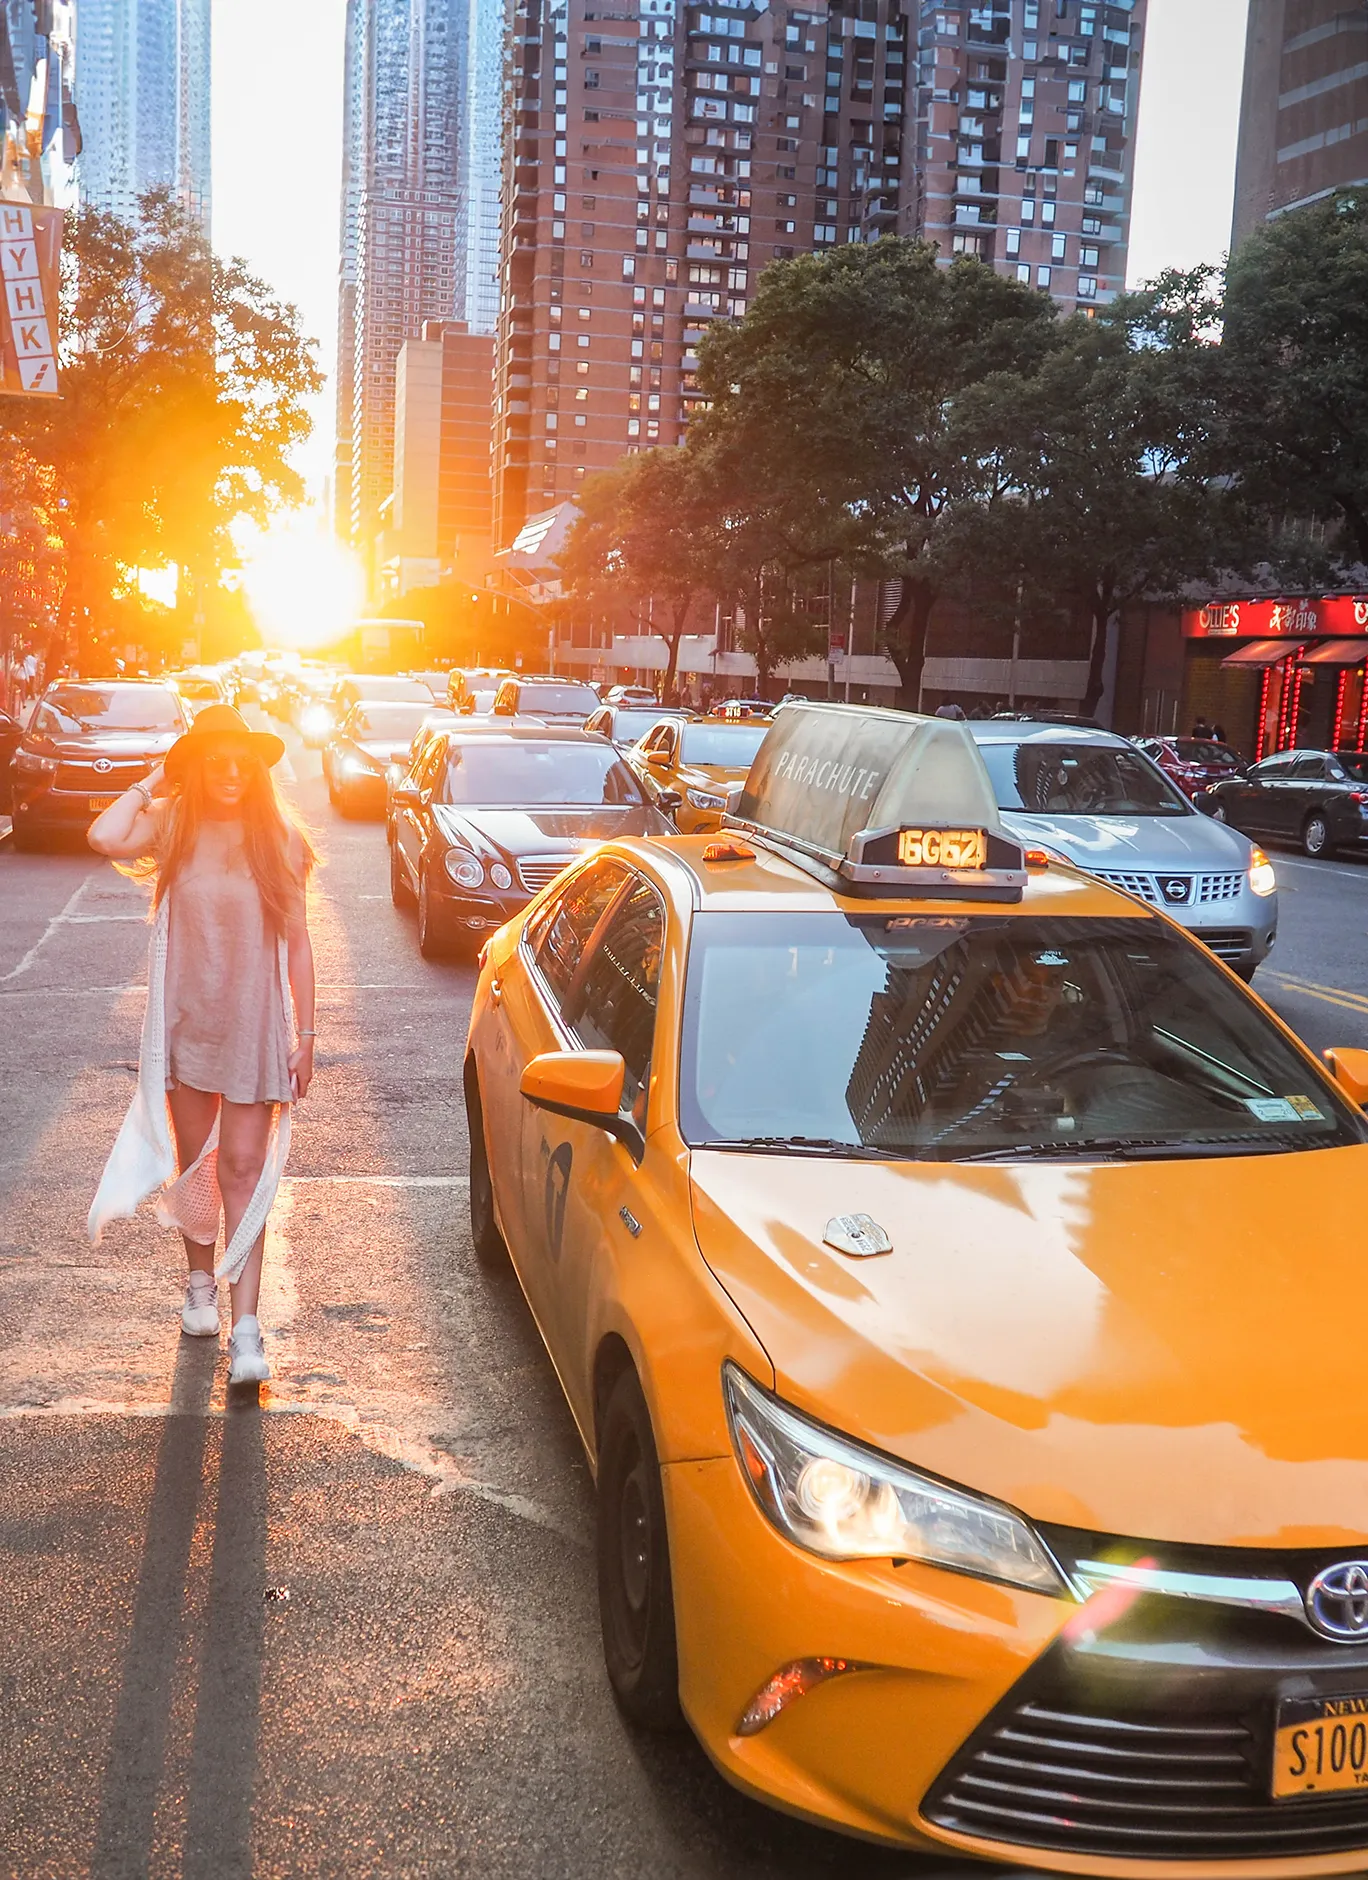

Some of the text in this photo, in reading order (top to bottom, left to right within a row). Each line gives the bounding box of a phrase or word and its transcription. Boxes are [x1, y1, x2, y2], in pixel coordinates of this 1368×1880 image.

[1199, 604, 1240, 628] OLLIE'S
[775, 751, 880, 800] PARACHUTE
[1324, 1699, 1367, 1717] NEW
[1289, 1723, 1366, 1777] S100
